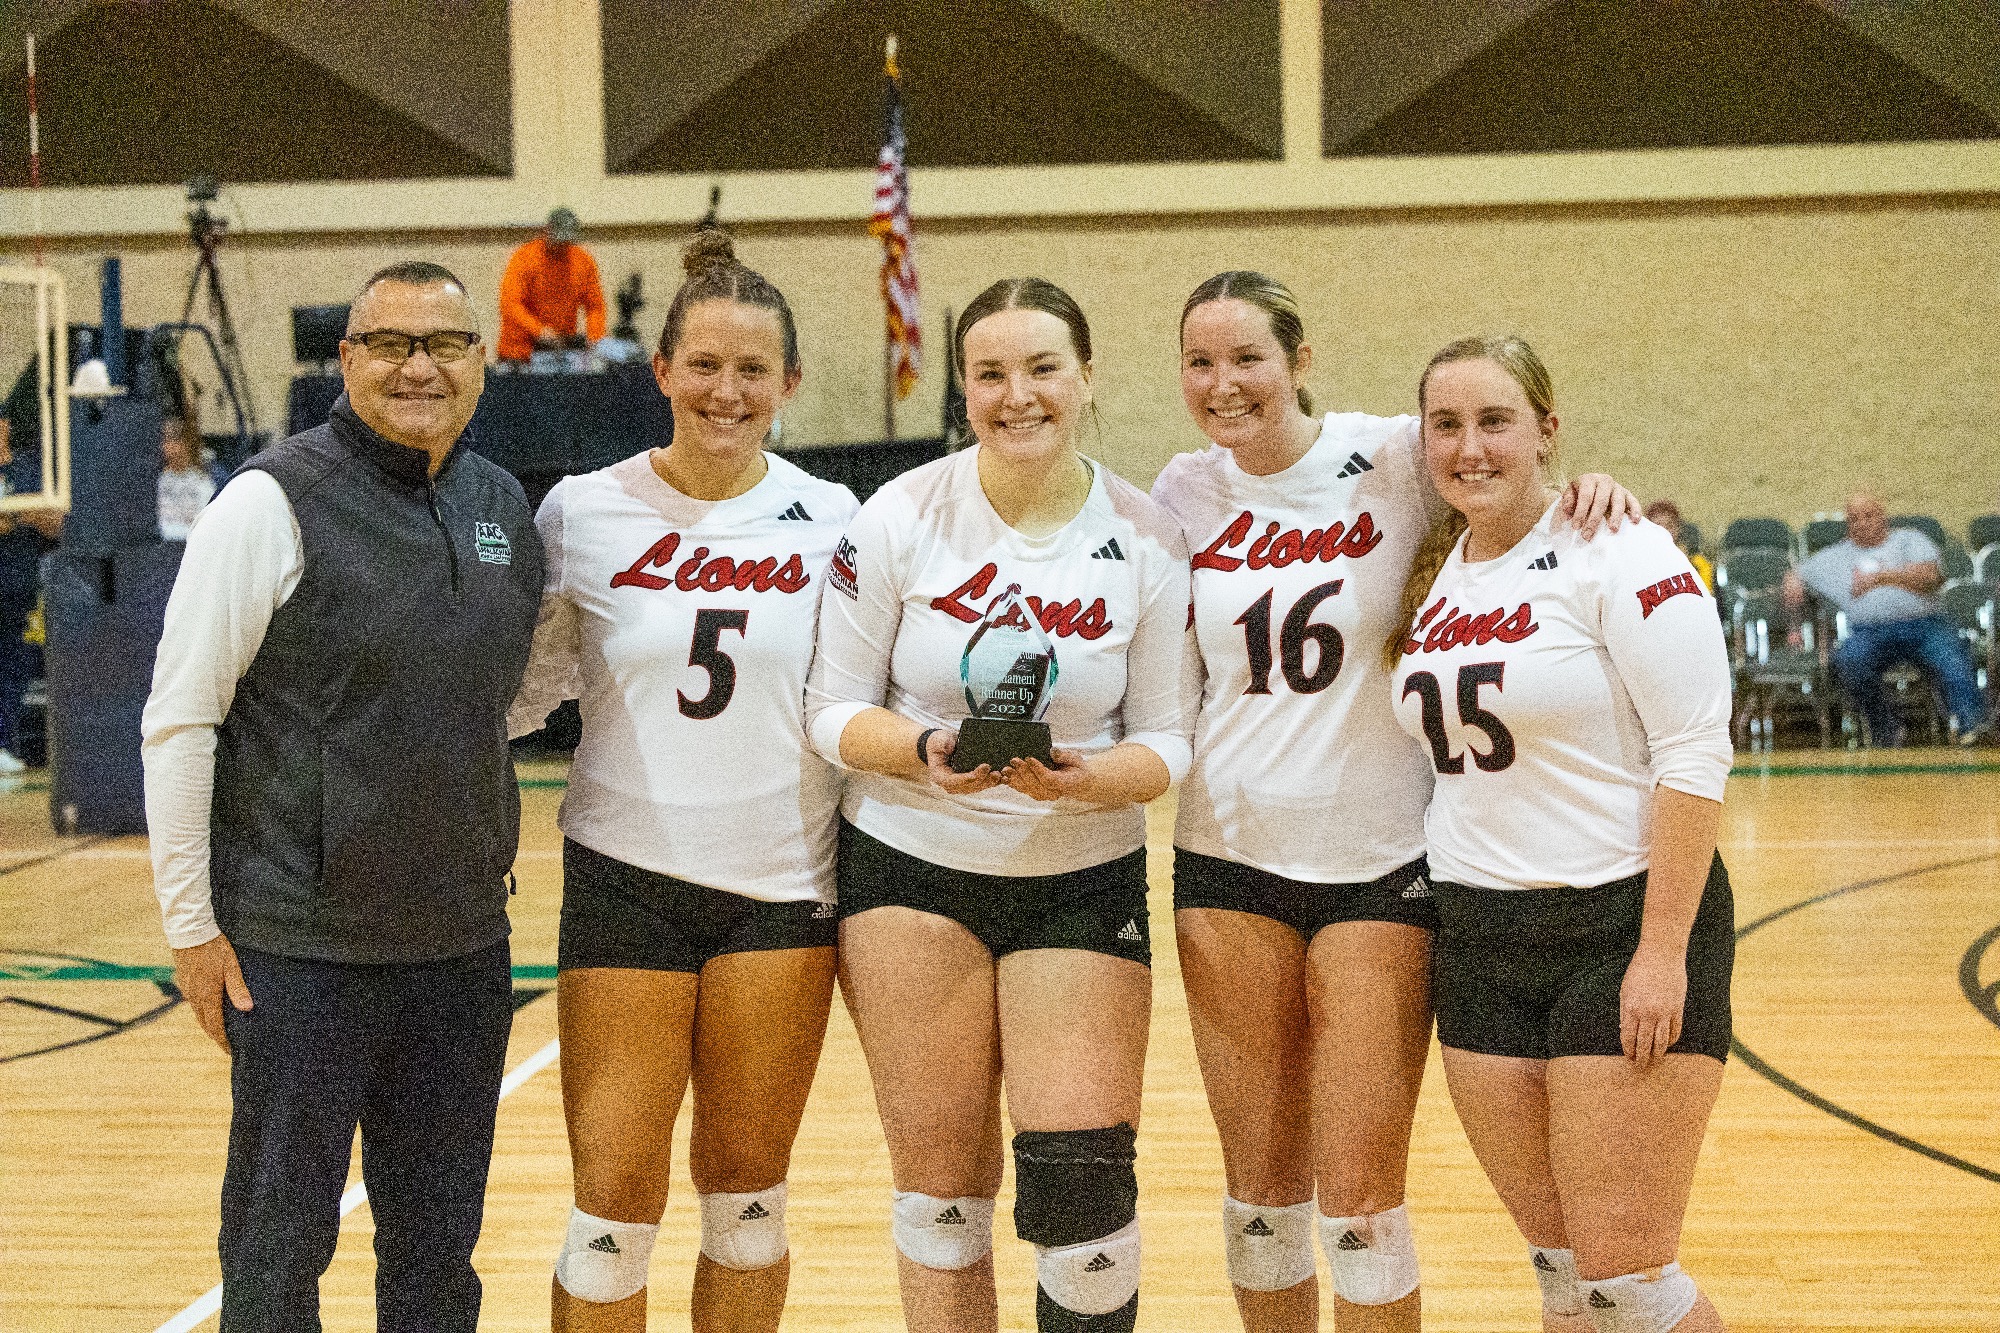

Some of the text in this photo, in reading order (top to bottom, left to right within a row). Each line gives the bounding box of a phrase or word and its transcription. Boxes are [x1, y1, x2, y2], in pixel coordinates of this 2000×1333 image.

[610, 532, 811, 594] Lions
[1192, 511, 1384, 572] Lions
[1403, 596, 1540, 656] Lions
[1636, 572, 1703, 620] NAIA
[677, 608, 750, 720] 5
[1233, 578, 1345, 696] 16
[981, 686, 1034, 704] Runner Up
[988, 703, 1026, 715] 2023
[1402, 661, 1516, 775] 25
